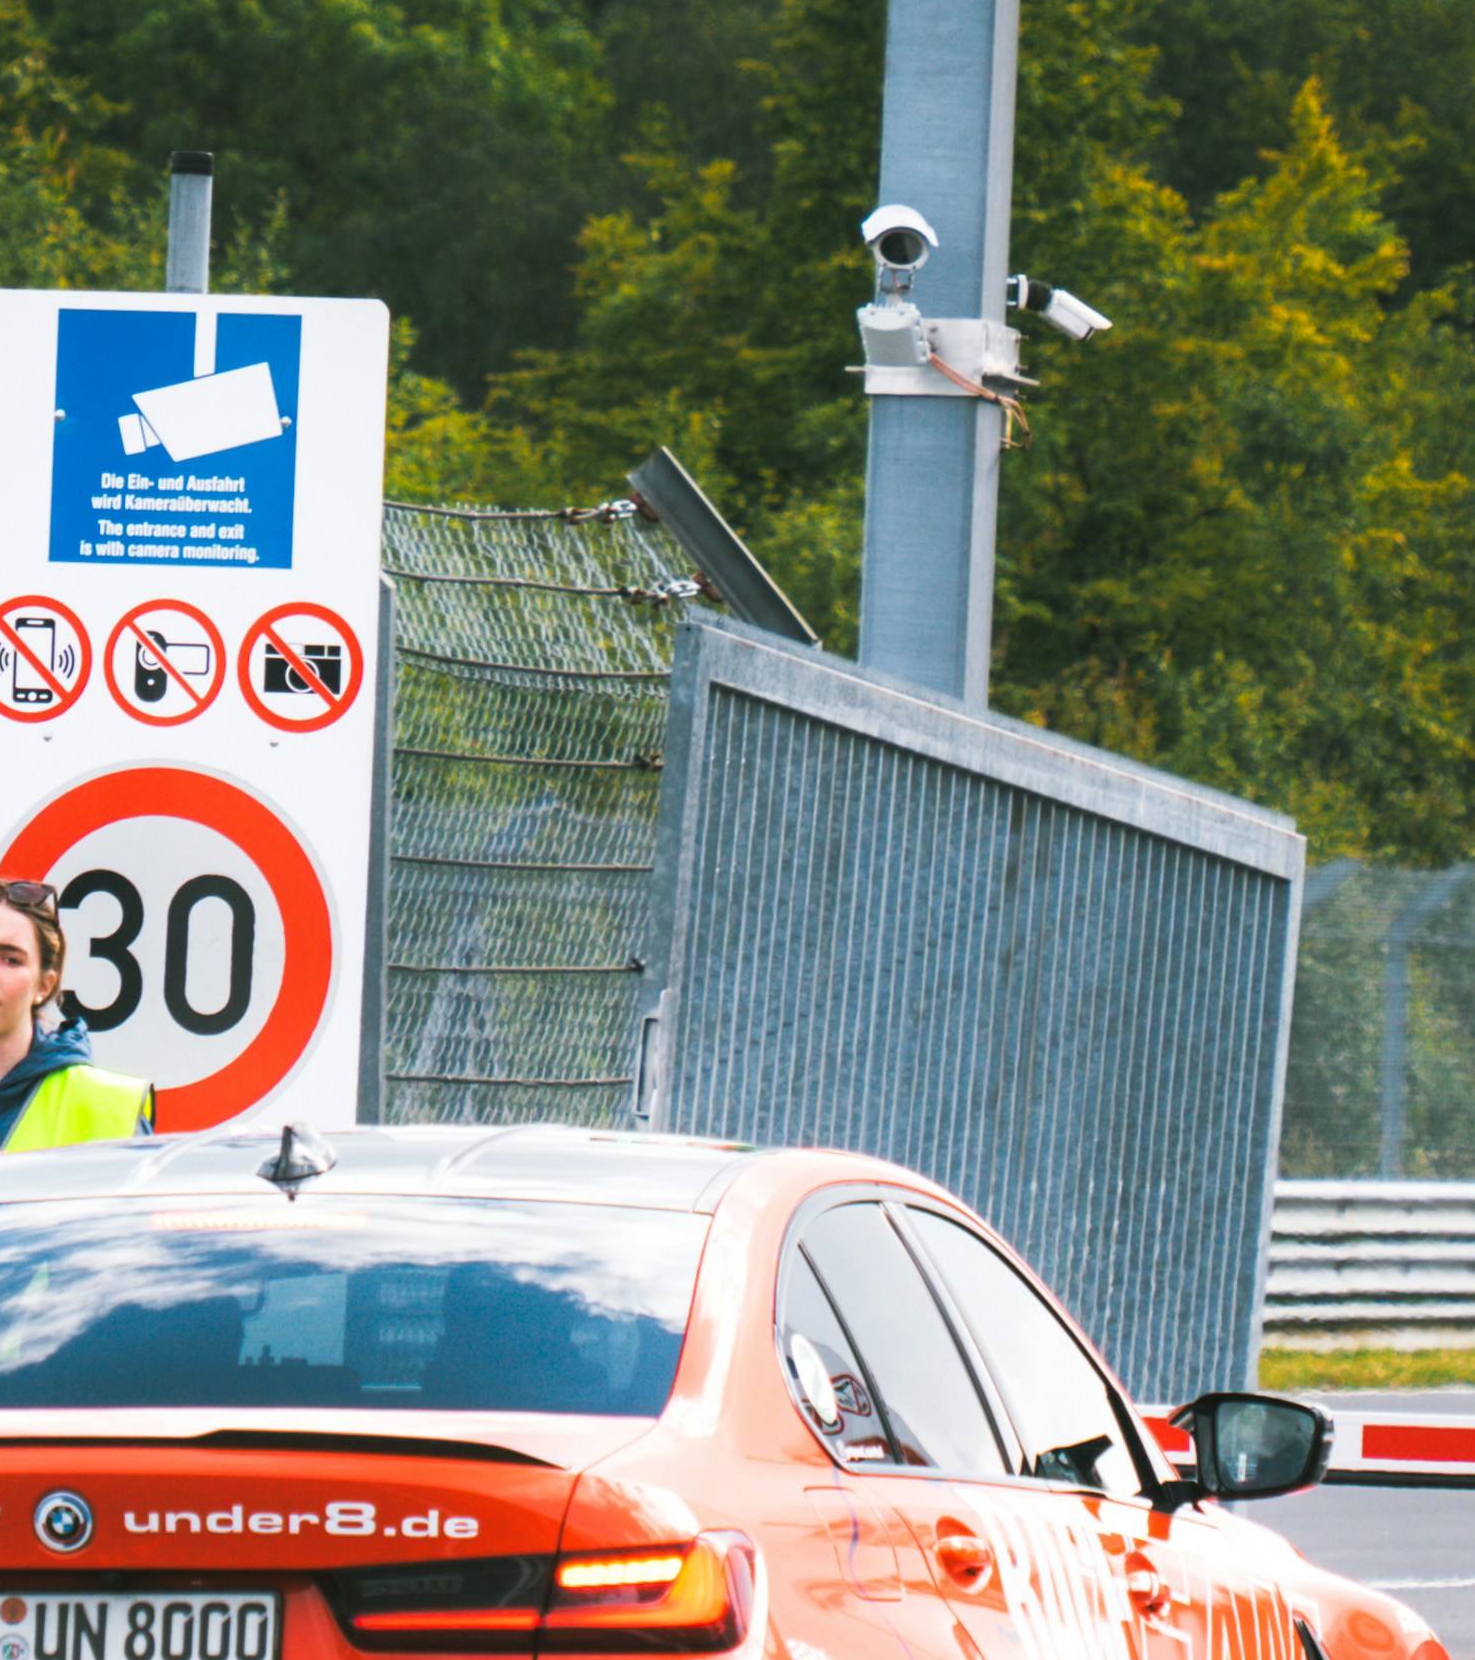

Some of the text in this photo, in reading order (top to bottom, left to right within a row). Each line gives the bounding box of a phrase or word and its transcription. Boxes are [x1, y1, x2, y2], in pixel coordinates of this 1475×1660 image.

[101, 473, 245, 492] Die Ein- und Ausfahrt
[91, 494, 252, 513] wird Kameraüberwacht.
[98, 520, 244, 539] The entrance and exit
[80, 540, 260, 564] is with camera monitoring.
[59, 869, 255, 1035] 30
[124, 1502, 479, 1539] under8.de
